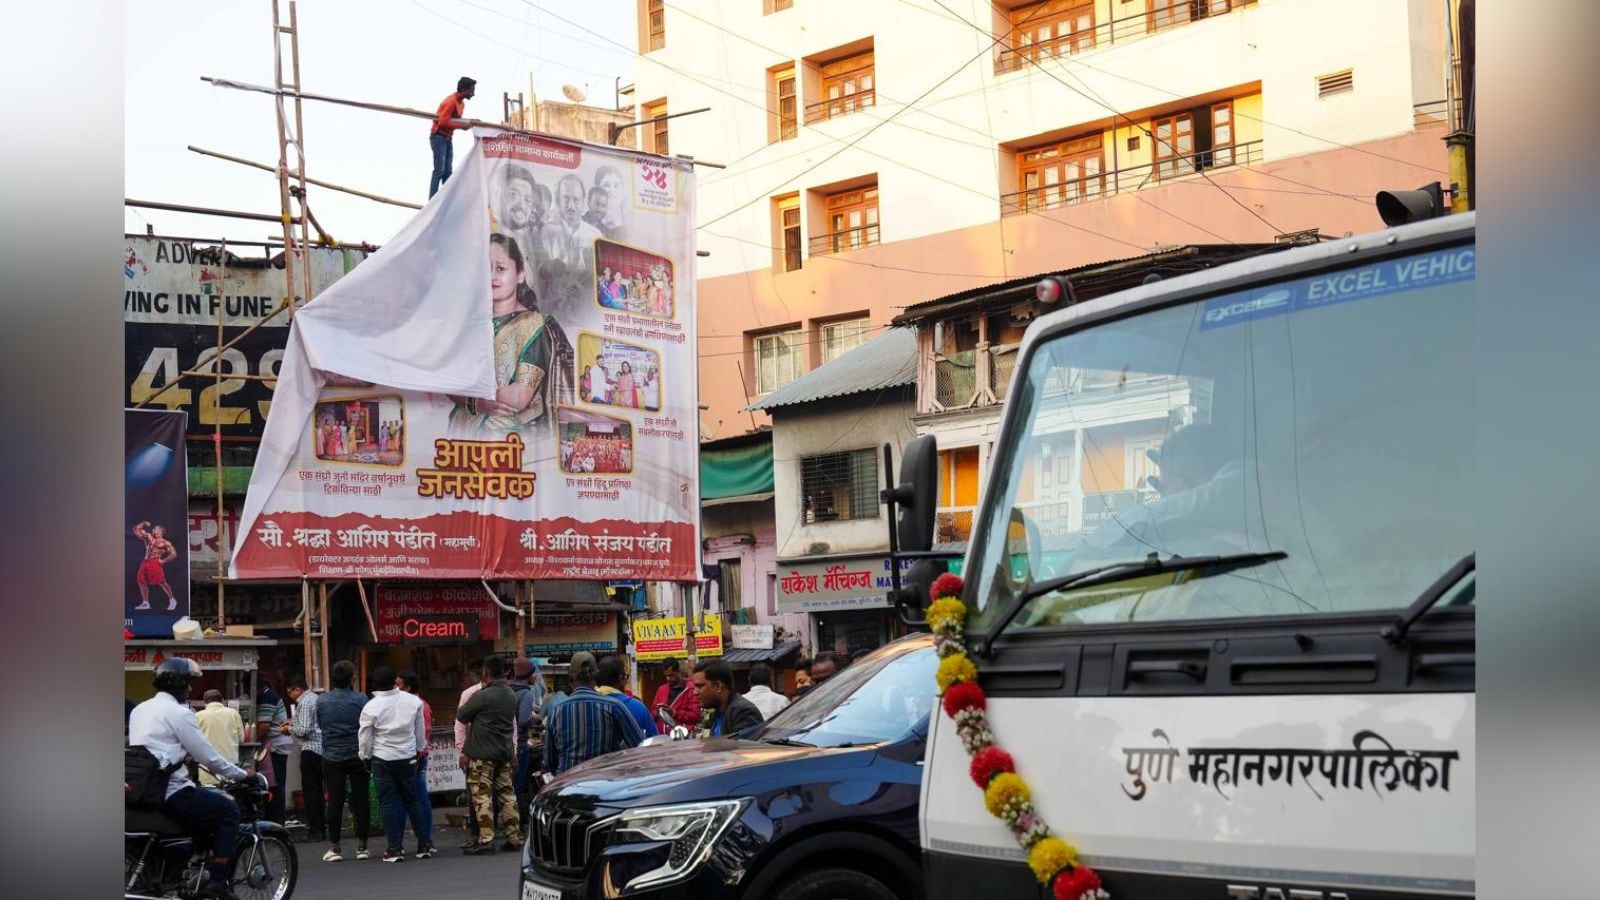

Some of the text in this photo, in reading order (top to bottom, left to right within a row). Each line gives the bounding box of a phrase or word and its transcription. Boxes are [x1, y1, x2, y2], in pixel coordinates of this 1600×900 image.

[1307, 269, 1387, 300] EXCEL
[177, 294, 200, 315] IN
[434, 432, 525, 470] आपली
[298, 470, 313, 481] एक
[315, 470, 331, 481] संधी
[416, 461, 536, 499] जनसेवक
[292, 525, 331, 549] श्रद्धा
[336, 523, 390, 549] आशिष
[391, 523, 437, 550] पंडीत
[546, 528, 590, 551] आशिष
[592, 529, 634, 554] संजय
[636, 529, 673, 554] पंडीत
[780, 570, 819, 595] राकेश
[823, 565, 872, 591] मॅचिंग्ज
[636, 622, 677, 638] VIVAAN
[1120, 729, 1460, 801] पुणे महानगरपालिका
